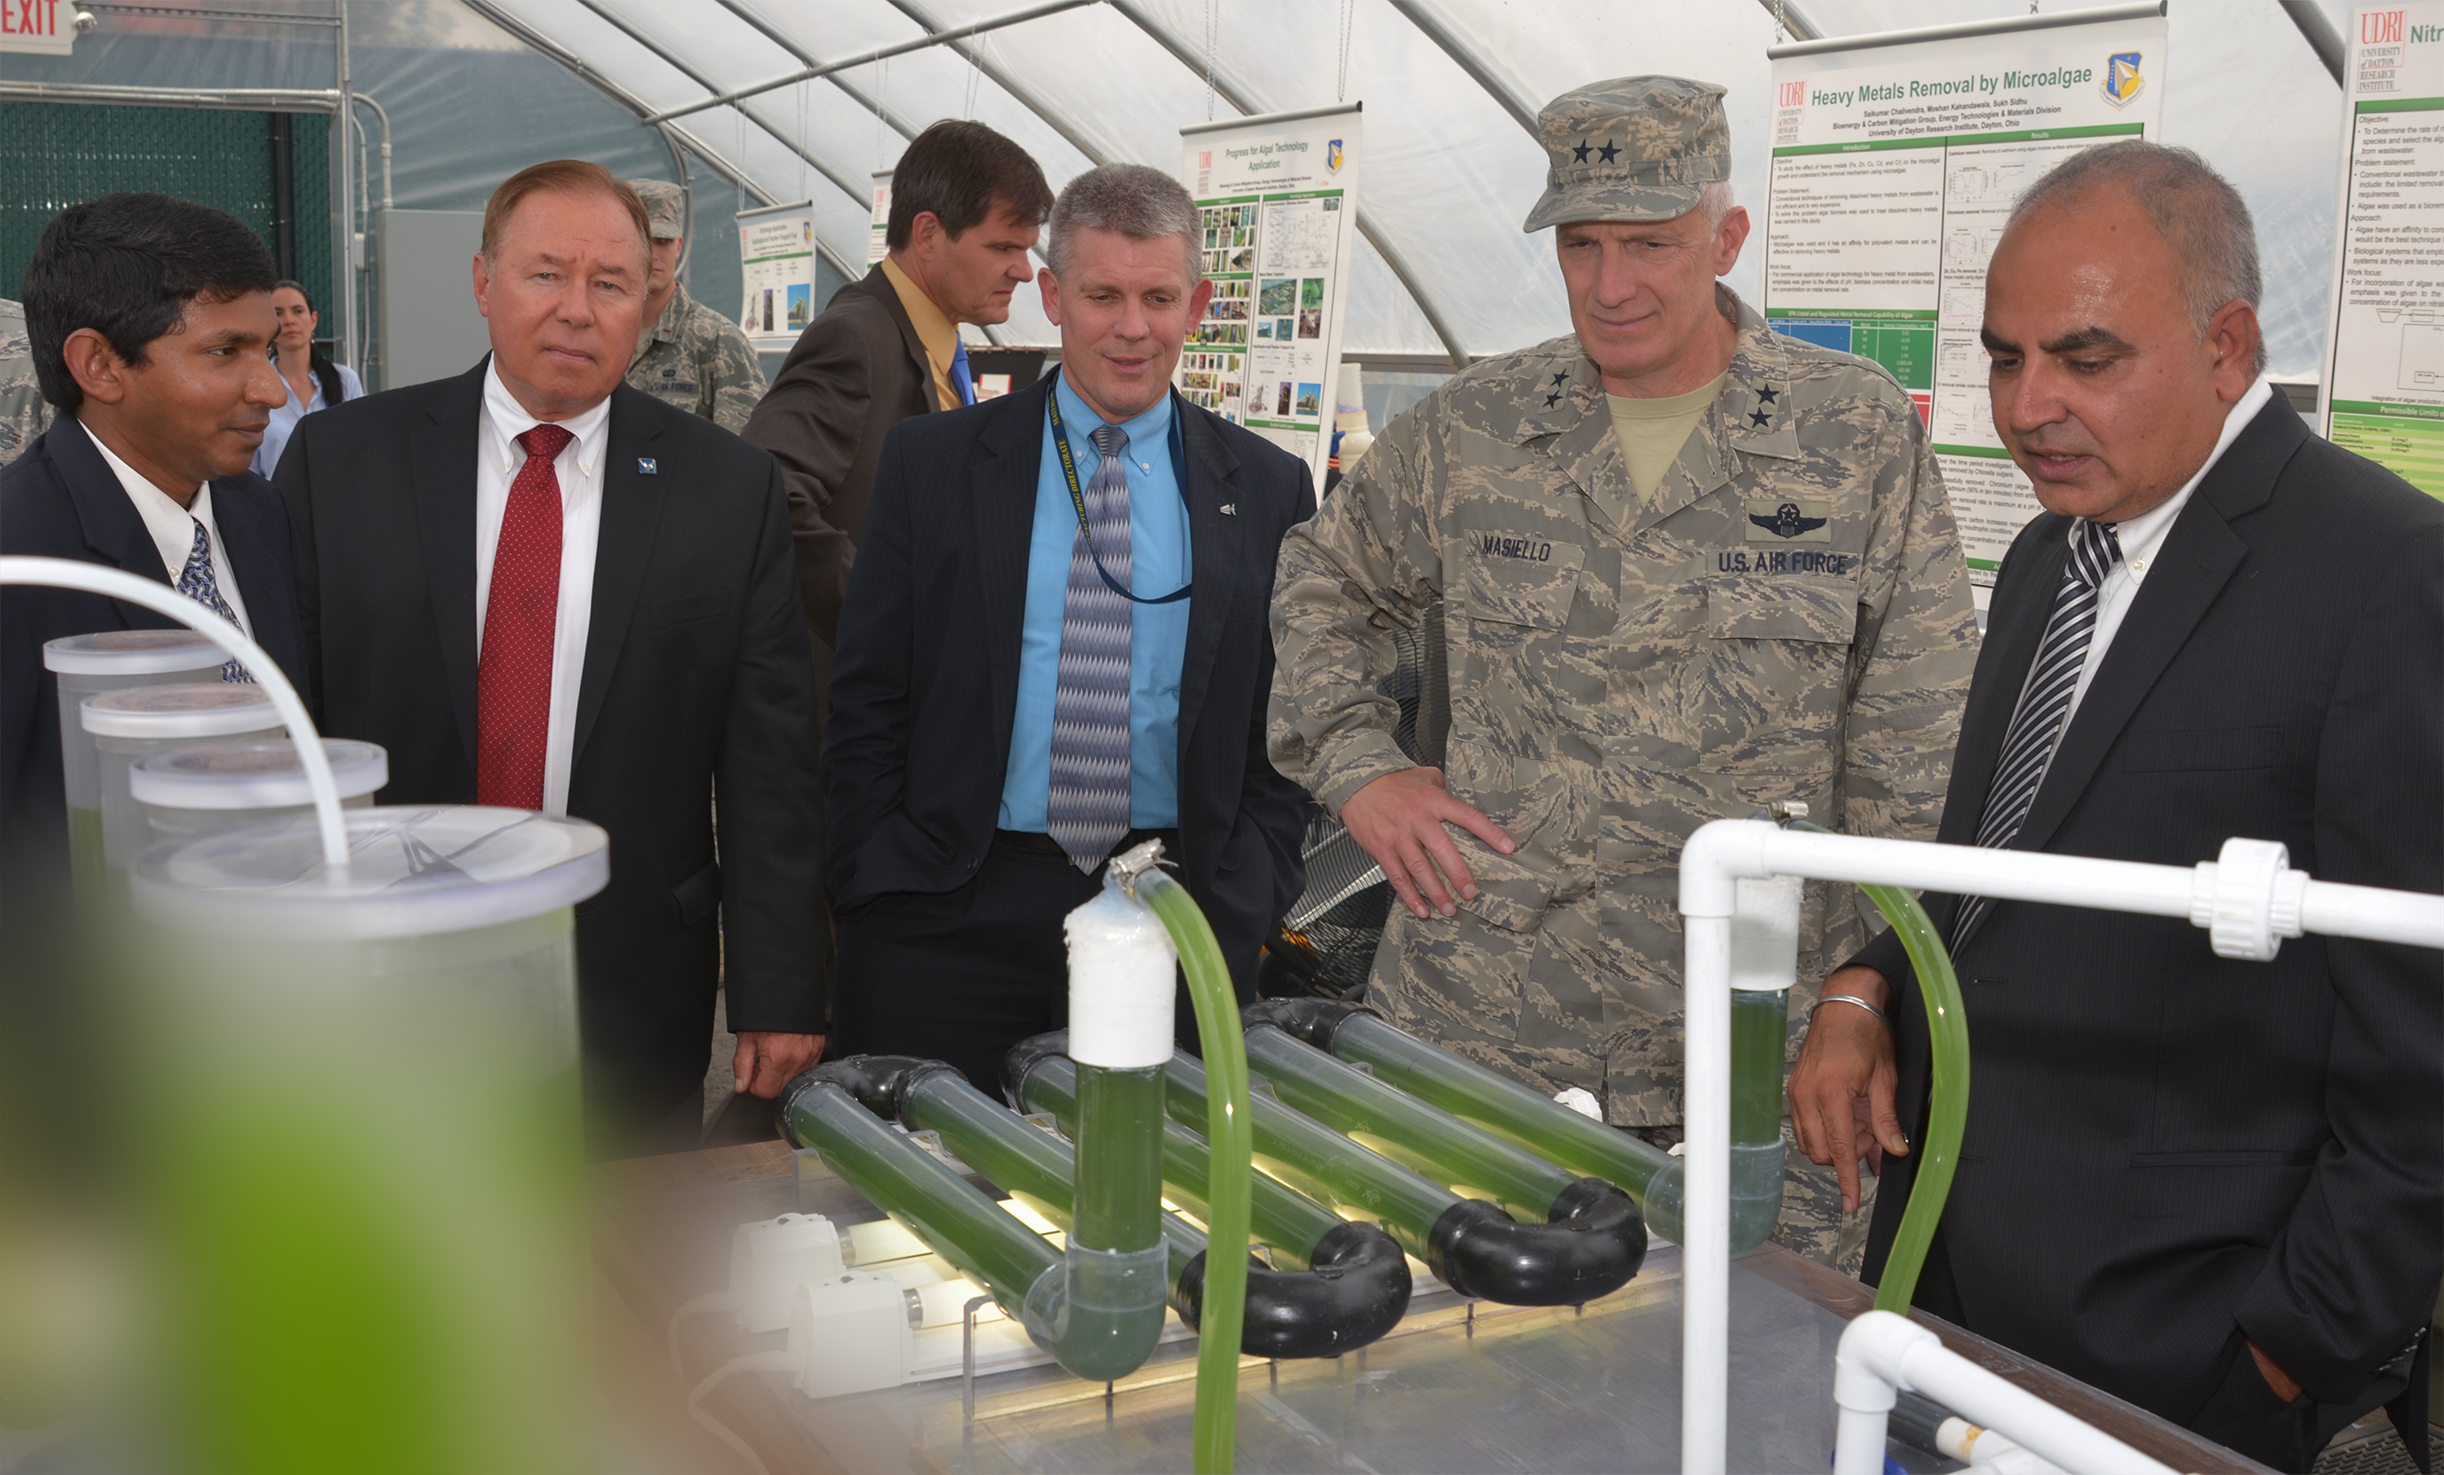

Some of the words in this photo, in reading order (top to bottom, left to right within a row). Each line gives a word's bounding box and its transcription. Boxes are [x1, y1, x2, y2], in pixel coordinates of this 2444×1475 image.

[1, 0, 59, 36] EXIT
[2361, 10, 2404, 45] UDRI
[2361, 46, 2402, 57] UNIVERSITY
[2368, 58, 2395, 68] DAYTON
[2359, 70, 2395, 80] RESEARCH
[1780, 81, 1805, 107] UDRI
[1812, 90, 1853, 107] Heavy
[1858, 83, 1904, 101] Metals
[1909, 76, 1974, 96] Removal
[1979, 75, 1998, 94] by
[2003, 69, 2092, 88] Microalgae
[2359, 81, 2395, 91] INSTITUTE
[1993, 99, 2008, 107] Sukh
[1889, 118, 1916, 126] Mitigation
[1938, 114, 1958, 122] Energy
[1960, 111, 1999, 119] Technologies
[2000, 109, 2005, 117] &
[2035, 106, 2061, 114] Division
[1904, 127, 1924, 135] Dayton
[1926, 124, 1952, 132] Research
[1980, 121, 2003, 129] Dayton,
[2005, 119, 2020, 127] Ohio
[1226, 148, 1248, 159] Progress
[1259, 144, 1273, 156] Algal
[1275, 141, 1308, 152] Technology
[1248, 160, 1280, 171] Application
[2380, 405, 2417, 414] Permissible
[2419, 408, 2438, 416] Limits
[1058, 438, 1079, 493] DIRECTORATE
[1482, 535, 1551, 562] MASIELLO
[1719, 552, 1751, 572] U.S.
[1755, 551, 1787, 572] AIR
[1791, 551, 1848, 575] FORCE
